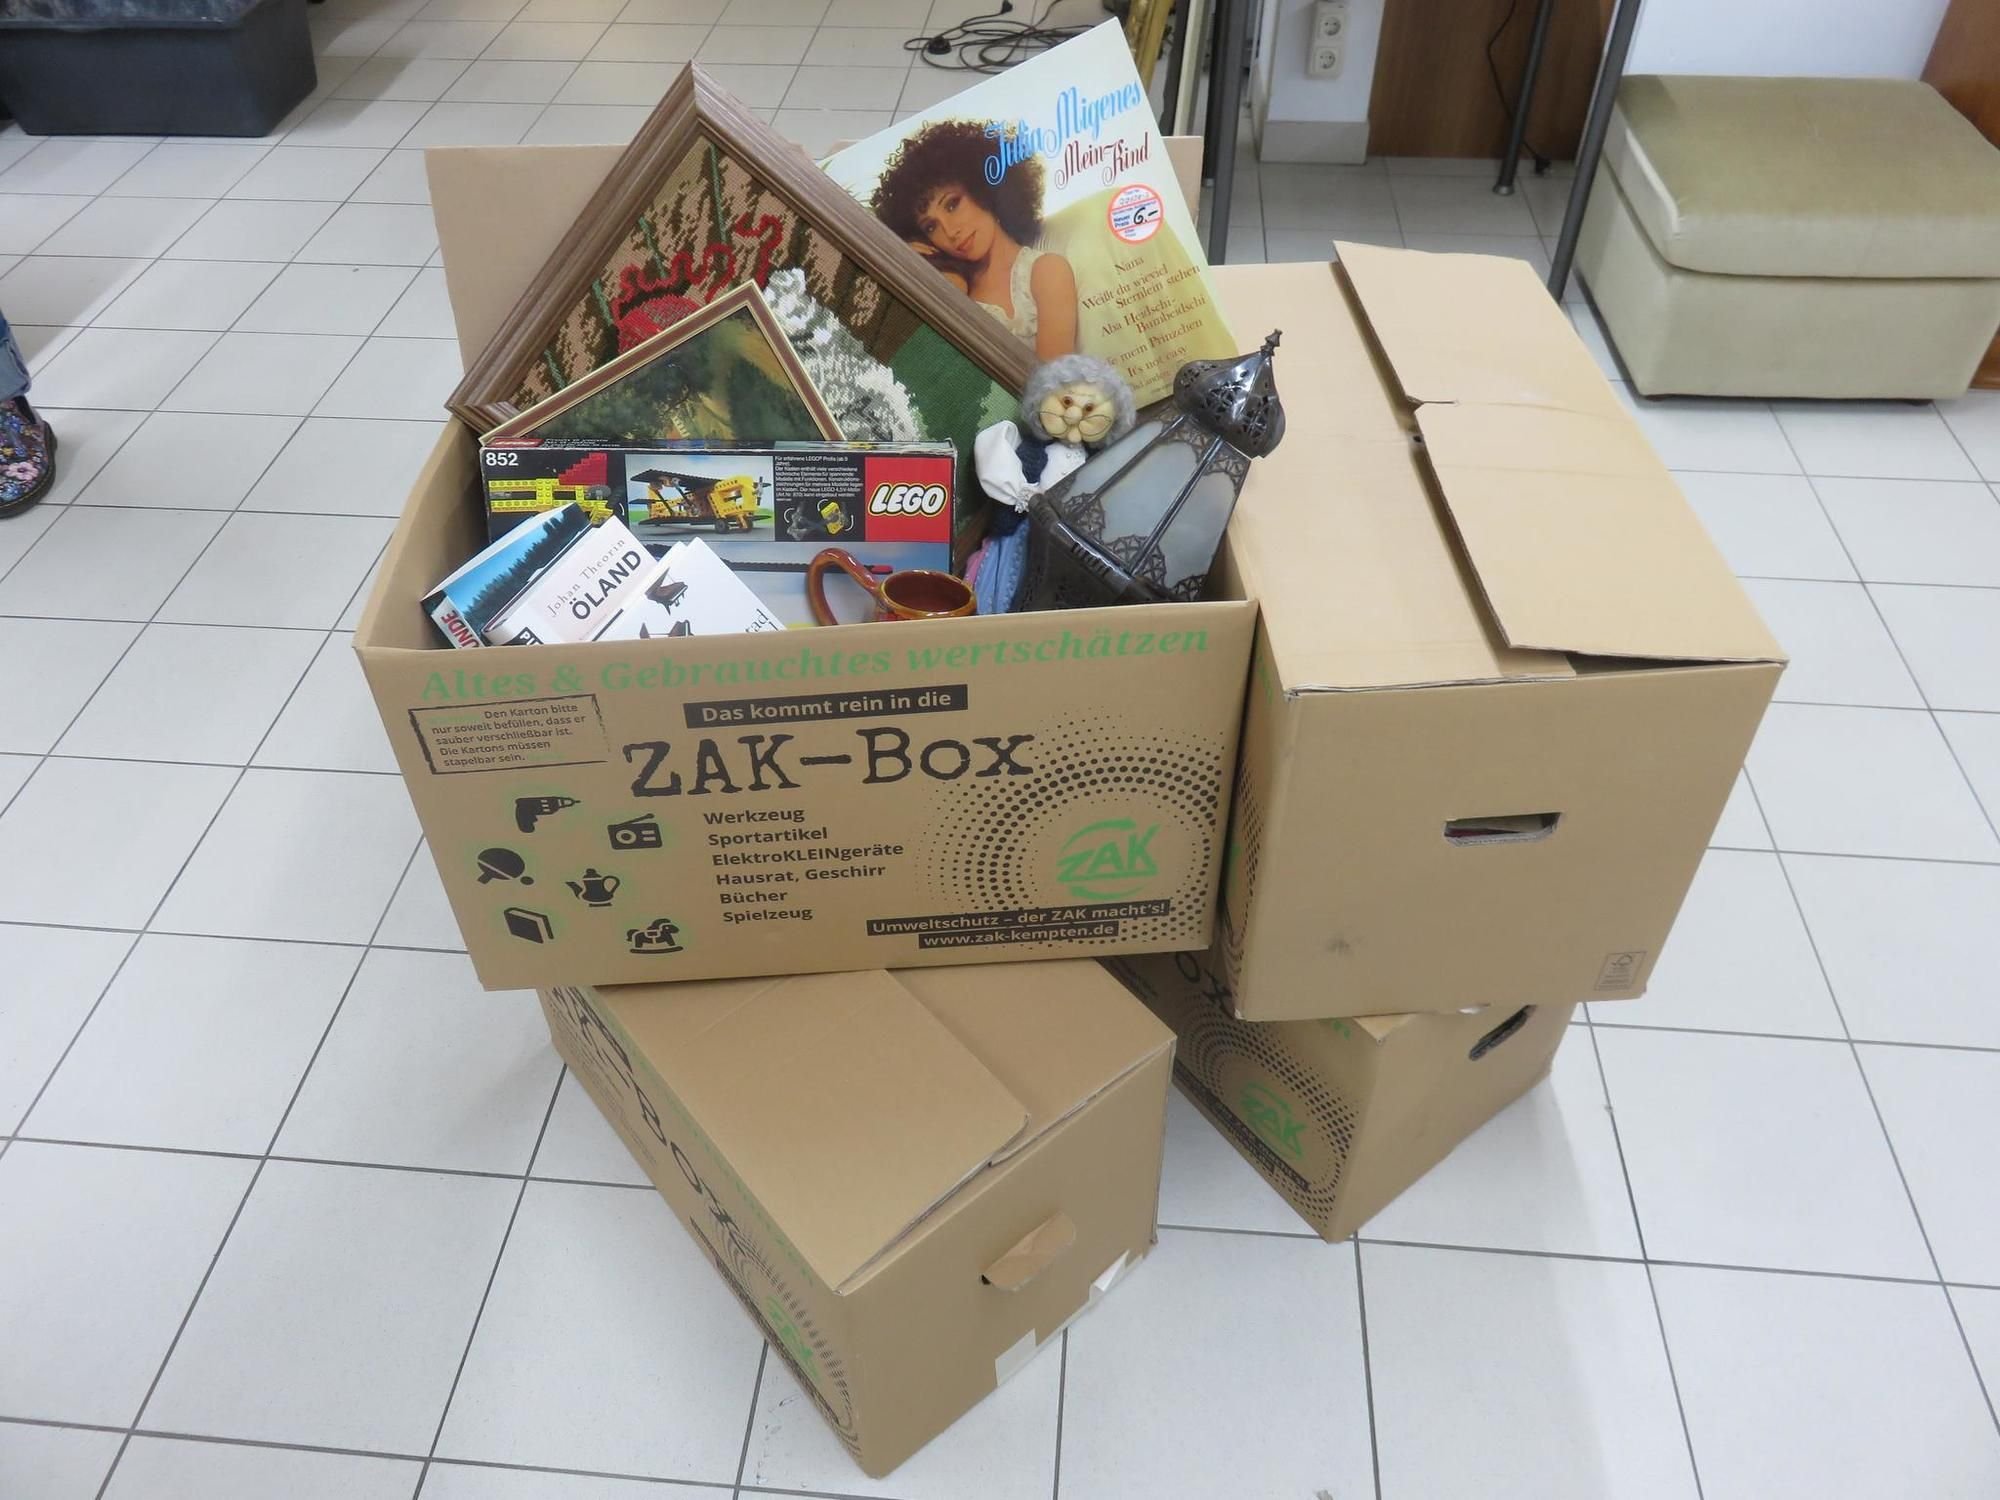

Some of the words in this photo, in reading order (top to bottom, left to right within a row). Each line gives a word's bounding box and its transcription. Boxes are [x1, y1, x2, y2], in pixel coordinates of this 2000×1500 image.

[1043, 79, 1141, 158] Migenes
[1055, 139, 1104, 190] Mein
[1102, 131, 1152, 186] Kind
[1114, 256, 1145, 275] Nana
[1116, 283, 1131, 297] du
[1133, 264, 1168, 288] wieviel
[1116, 283, 1164, 310] Sternlein
[1167, 265, 1201, 285] stehen
[1102, 322, 1123, 337] Aba
[1120, 344, 1149, 363] mein
[1149, 318, 1204, 348] Prinzchen
[485, 451, 519, 466] 852
[869, 483, 948, 517] LEGO
[547, 583, 581, 618] Johan
[580, 540, 625, 579] Theorin
[569, 550, 641, 619] ÖLAND
[421, 668, 537, 703] Altes
[551, 662, 585, 692] &
[601, 645, 892, 692] Gebrauchtes
[907, 628, 1209, 672] wertschätzen
[484, 709, 507, 719] Den
[510, 706, 549, 717] Karton
[551, 703, 579, 713] bitte
[703, 706, 744, 722] Das
[751, 701, 832, 719] kommt
[839, 697, 886, 713] rein
[890, 694, 912, 710] in
[918, 691, 952, 707] die
[432, 726, 452, 735] nur
[454, 722, 493, 733] soweit
[494, 718, 544, 731] befüllen,
[546, 715, 573, 725] dass
[574, 715, 586, 723] er
[436, 735, 475, 746] sauber
[476, 727, 553, 743] verschließbar
[555, 727, 573, 736] ist.
[440, 747, 459, 756] Die
[461, 743, 505, 754] Kartons
[507, 740, 551, 751] müssen
[443, 756, 496, 768] stapelbar
[498, 752, 525, 763] sein.
[703, 808, 805, 825] Werkzeug
[708, 827, 828, 848] Sportartikel
[712, 843, 904, 866] ElektroKLEINgeräte
[1056, 823, 1162, 883] ZAK
[716, 871, 799, 885] Hausrat,
[804, 864, 887, 880] Geschirr
[720, 890, 788, 904] Bücher
[723, 908, 814, 924] Spielzeug
[872, 913, 999, 934] Umweltschutz
[1017, 910, 1046, 924] der
[1052, 907, 1087, 921] ZAK
[923, 923, 1115, 946] www.zak-kempten.de
